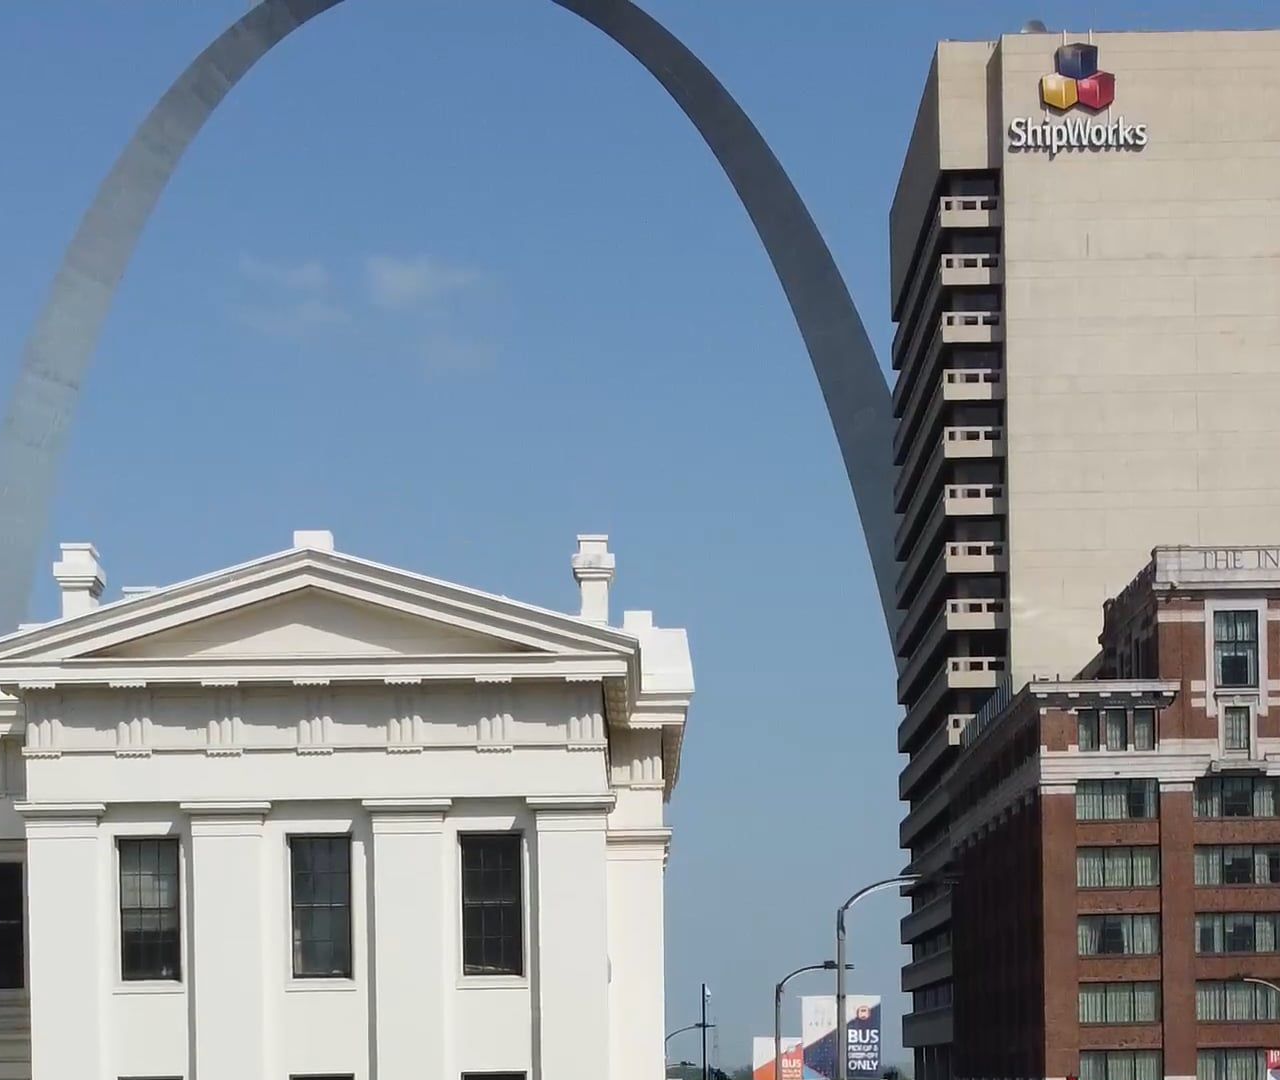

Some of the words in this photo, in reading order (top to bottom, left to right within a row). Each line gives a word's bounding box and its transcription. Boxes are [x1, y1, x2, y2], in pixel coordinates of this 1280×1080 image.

[1010, 116, 1148, 154] ShipWorks
[1200, 550, 1244, 569] THE
[848, 1029, 879, 1043] BUS
[782, 1059, 801, 1068] BUS
[848, 1060, 879, 1070] ONLY
